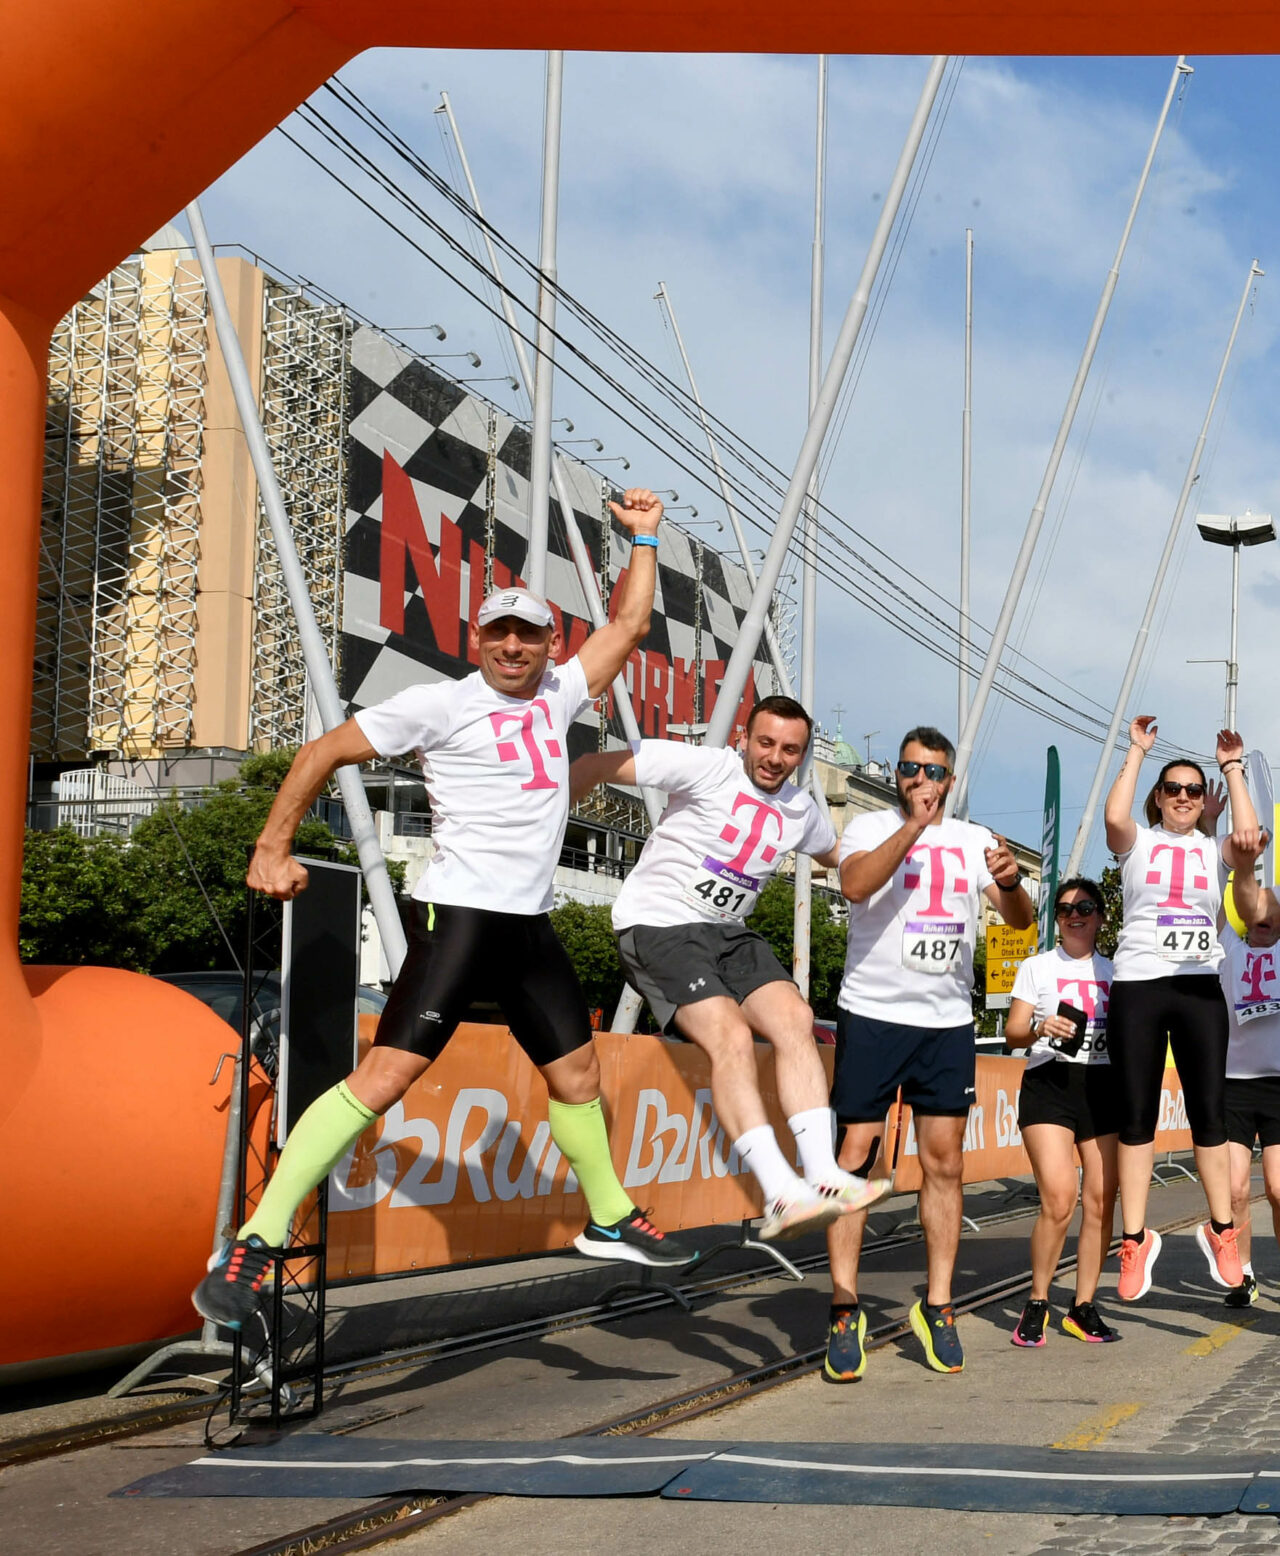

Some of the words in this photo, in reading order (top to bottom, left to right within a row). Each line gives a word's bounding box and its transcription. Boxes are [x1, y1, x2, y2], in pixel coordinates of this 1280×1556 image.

[694, 879, 746, 912] 481
[1001, 927, 1016, 937] Split
[1001, 937, 1024, 946] Zagreb
[1163, 930, 1210, 951] 478
[910, 938, 960, 961] 487
[1001, 949, 1015, 957] Otok
[1081, 1032, 1108, 1052] 56
[623, 1088, 750, 1188] B2Ru
